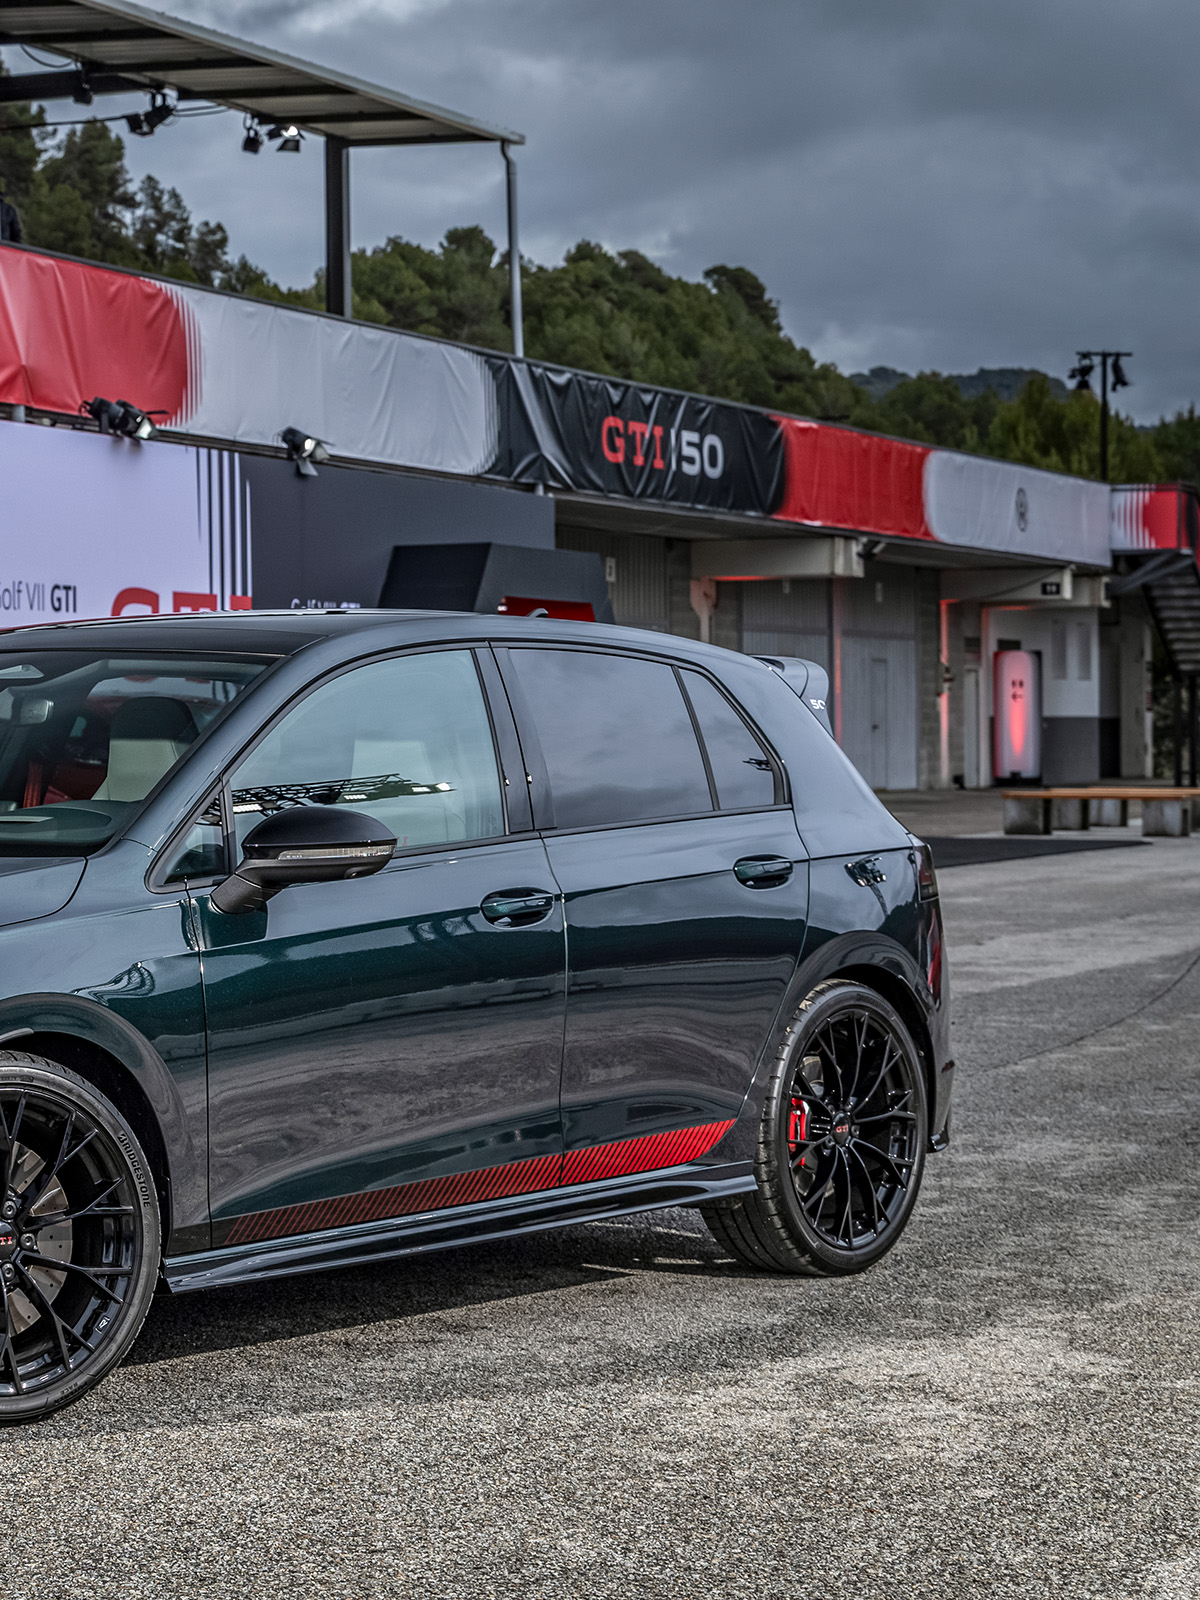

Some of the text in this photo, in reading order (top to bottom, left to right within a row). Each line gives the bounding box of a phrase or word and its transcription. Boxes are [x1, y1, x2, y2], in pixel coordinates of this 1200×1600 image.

[601, 416, 724, 479] GTI 50
[25, 582, 45, 611] VII
[50, 583, 77, 613] GTI
[835, 1124, 849, 1133] GTI
[117, 1133, 151, 1208] BRIDGESTONE
